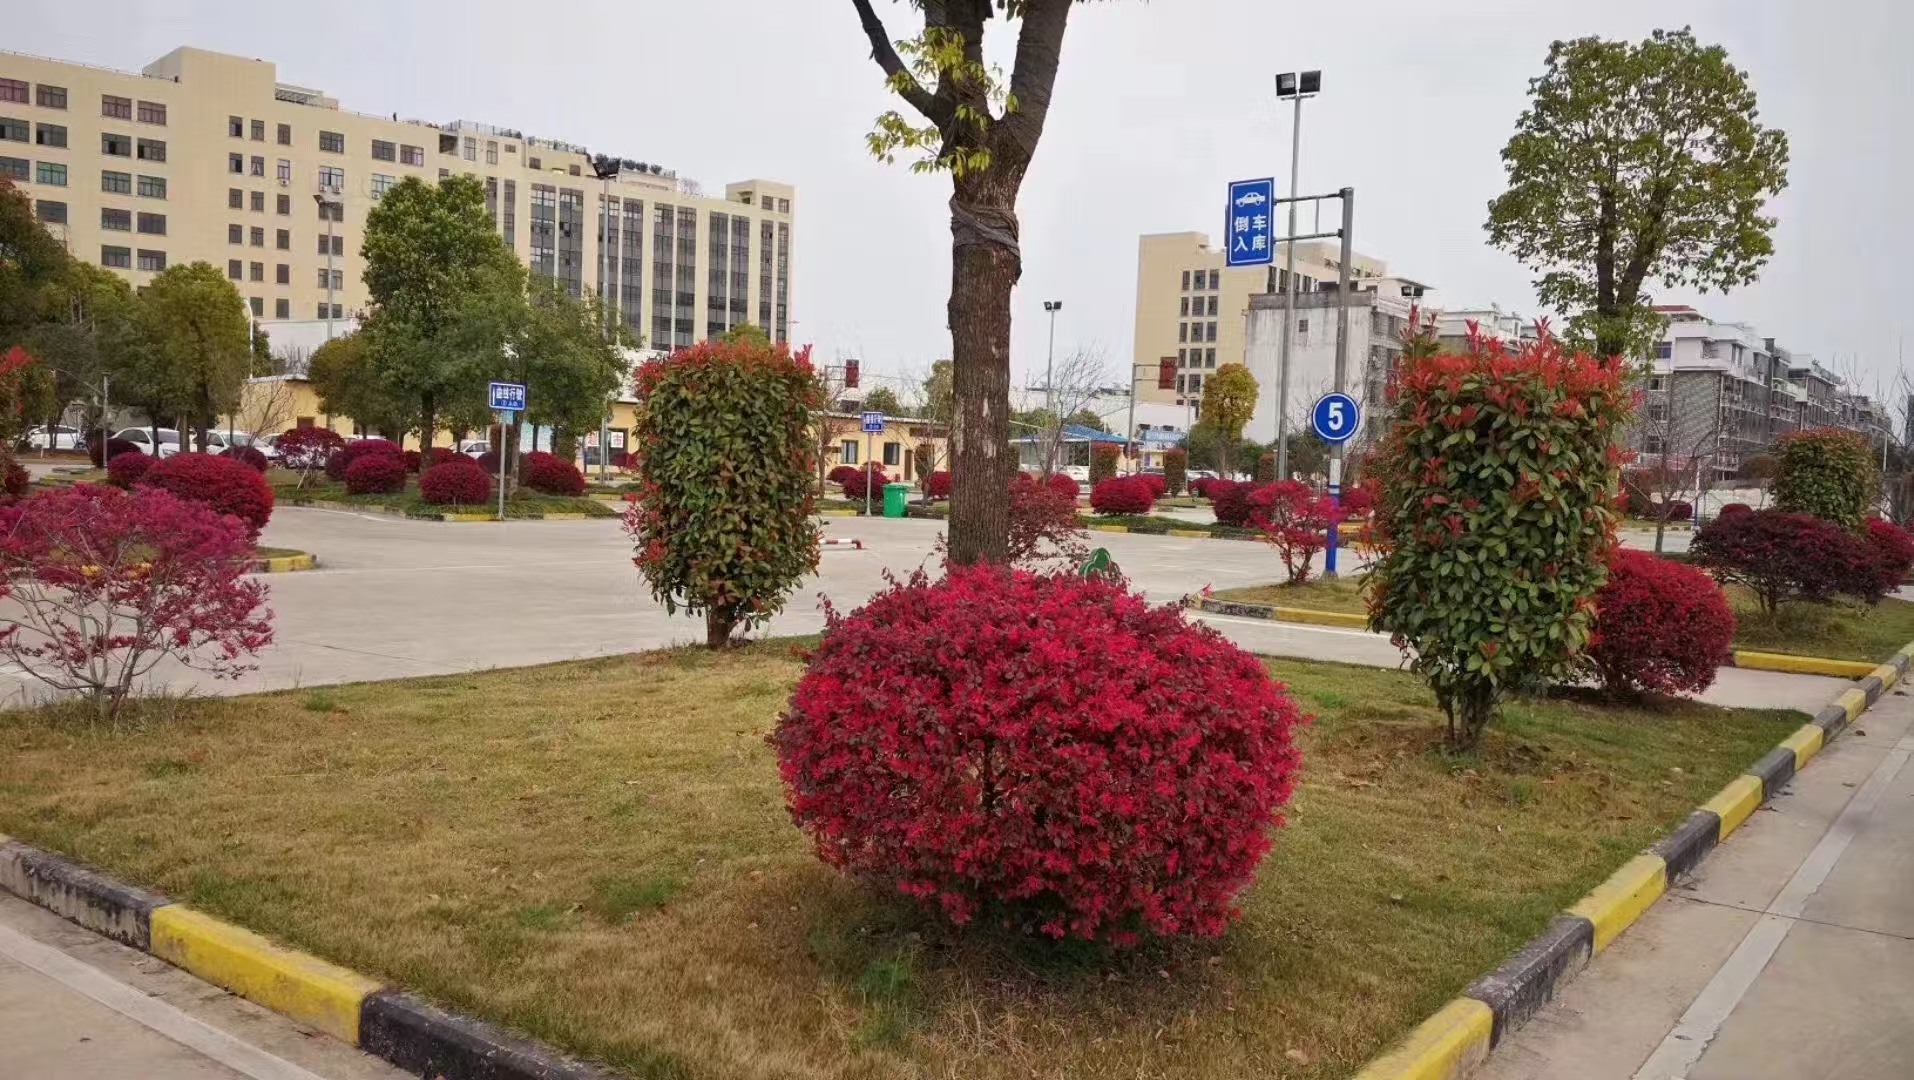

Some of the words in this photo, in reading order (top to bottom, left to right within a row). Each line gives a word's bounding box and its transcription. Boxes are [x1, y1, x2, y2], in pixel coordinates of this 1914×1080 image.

[1234, 214, 1267, 233] 倒车
[1234, 234, 1266, 252] 入库
[1328, 402, 1343, 430] 5
